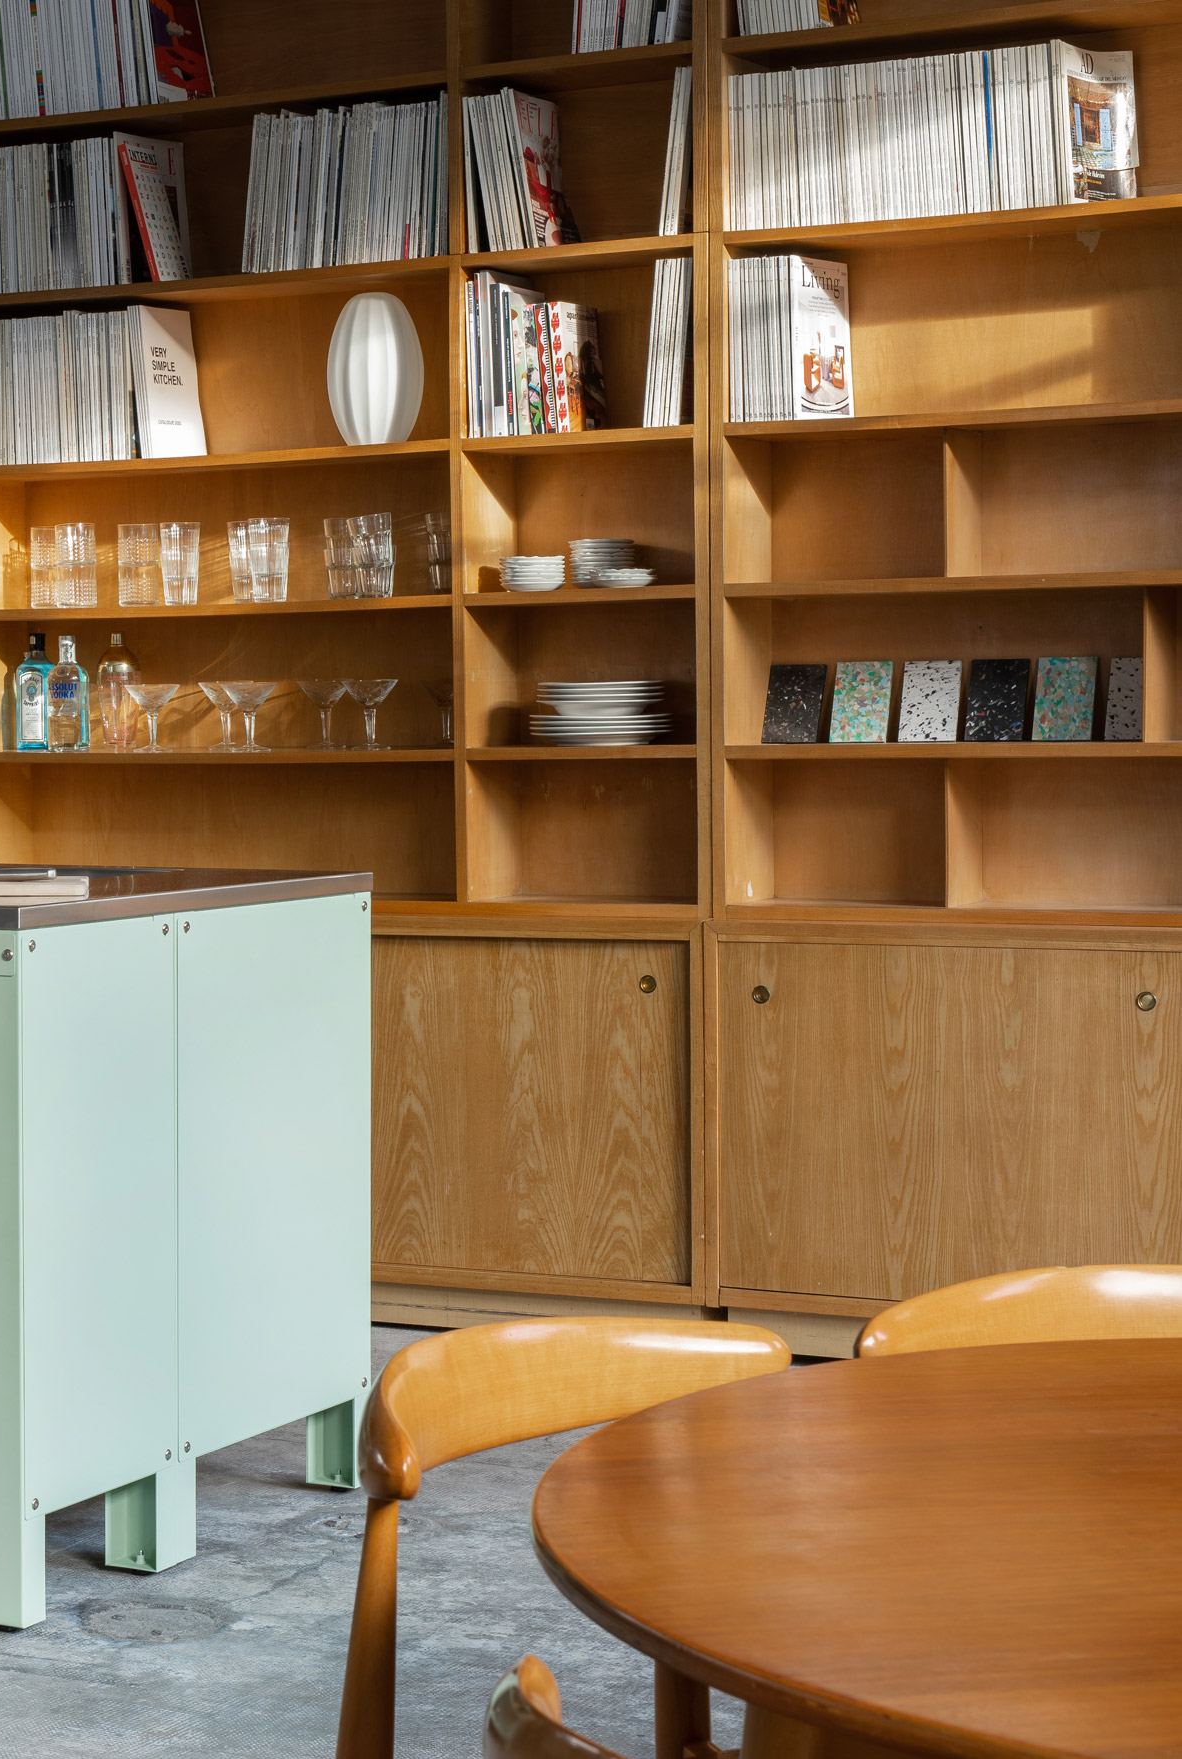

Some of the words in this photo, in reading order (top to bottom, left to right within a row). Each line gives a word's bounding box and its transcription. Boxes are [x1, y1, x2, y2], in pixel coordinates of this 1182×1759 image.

[1080, 52, 1094, 75] AD
[128, 149, 157, 166] INTERNI
[801, 264, 841, 299] Living
[150, 346, 167, 358] VERY
[151, 360, 176, 372] SIMPLE
[153, 374, 184, 386] KITCHEN.
[51, 690, 75, 699] VODKA
